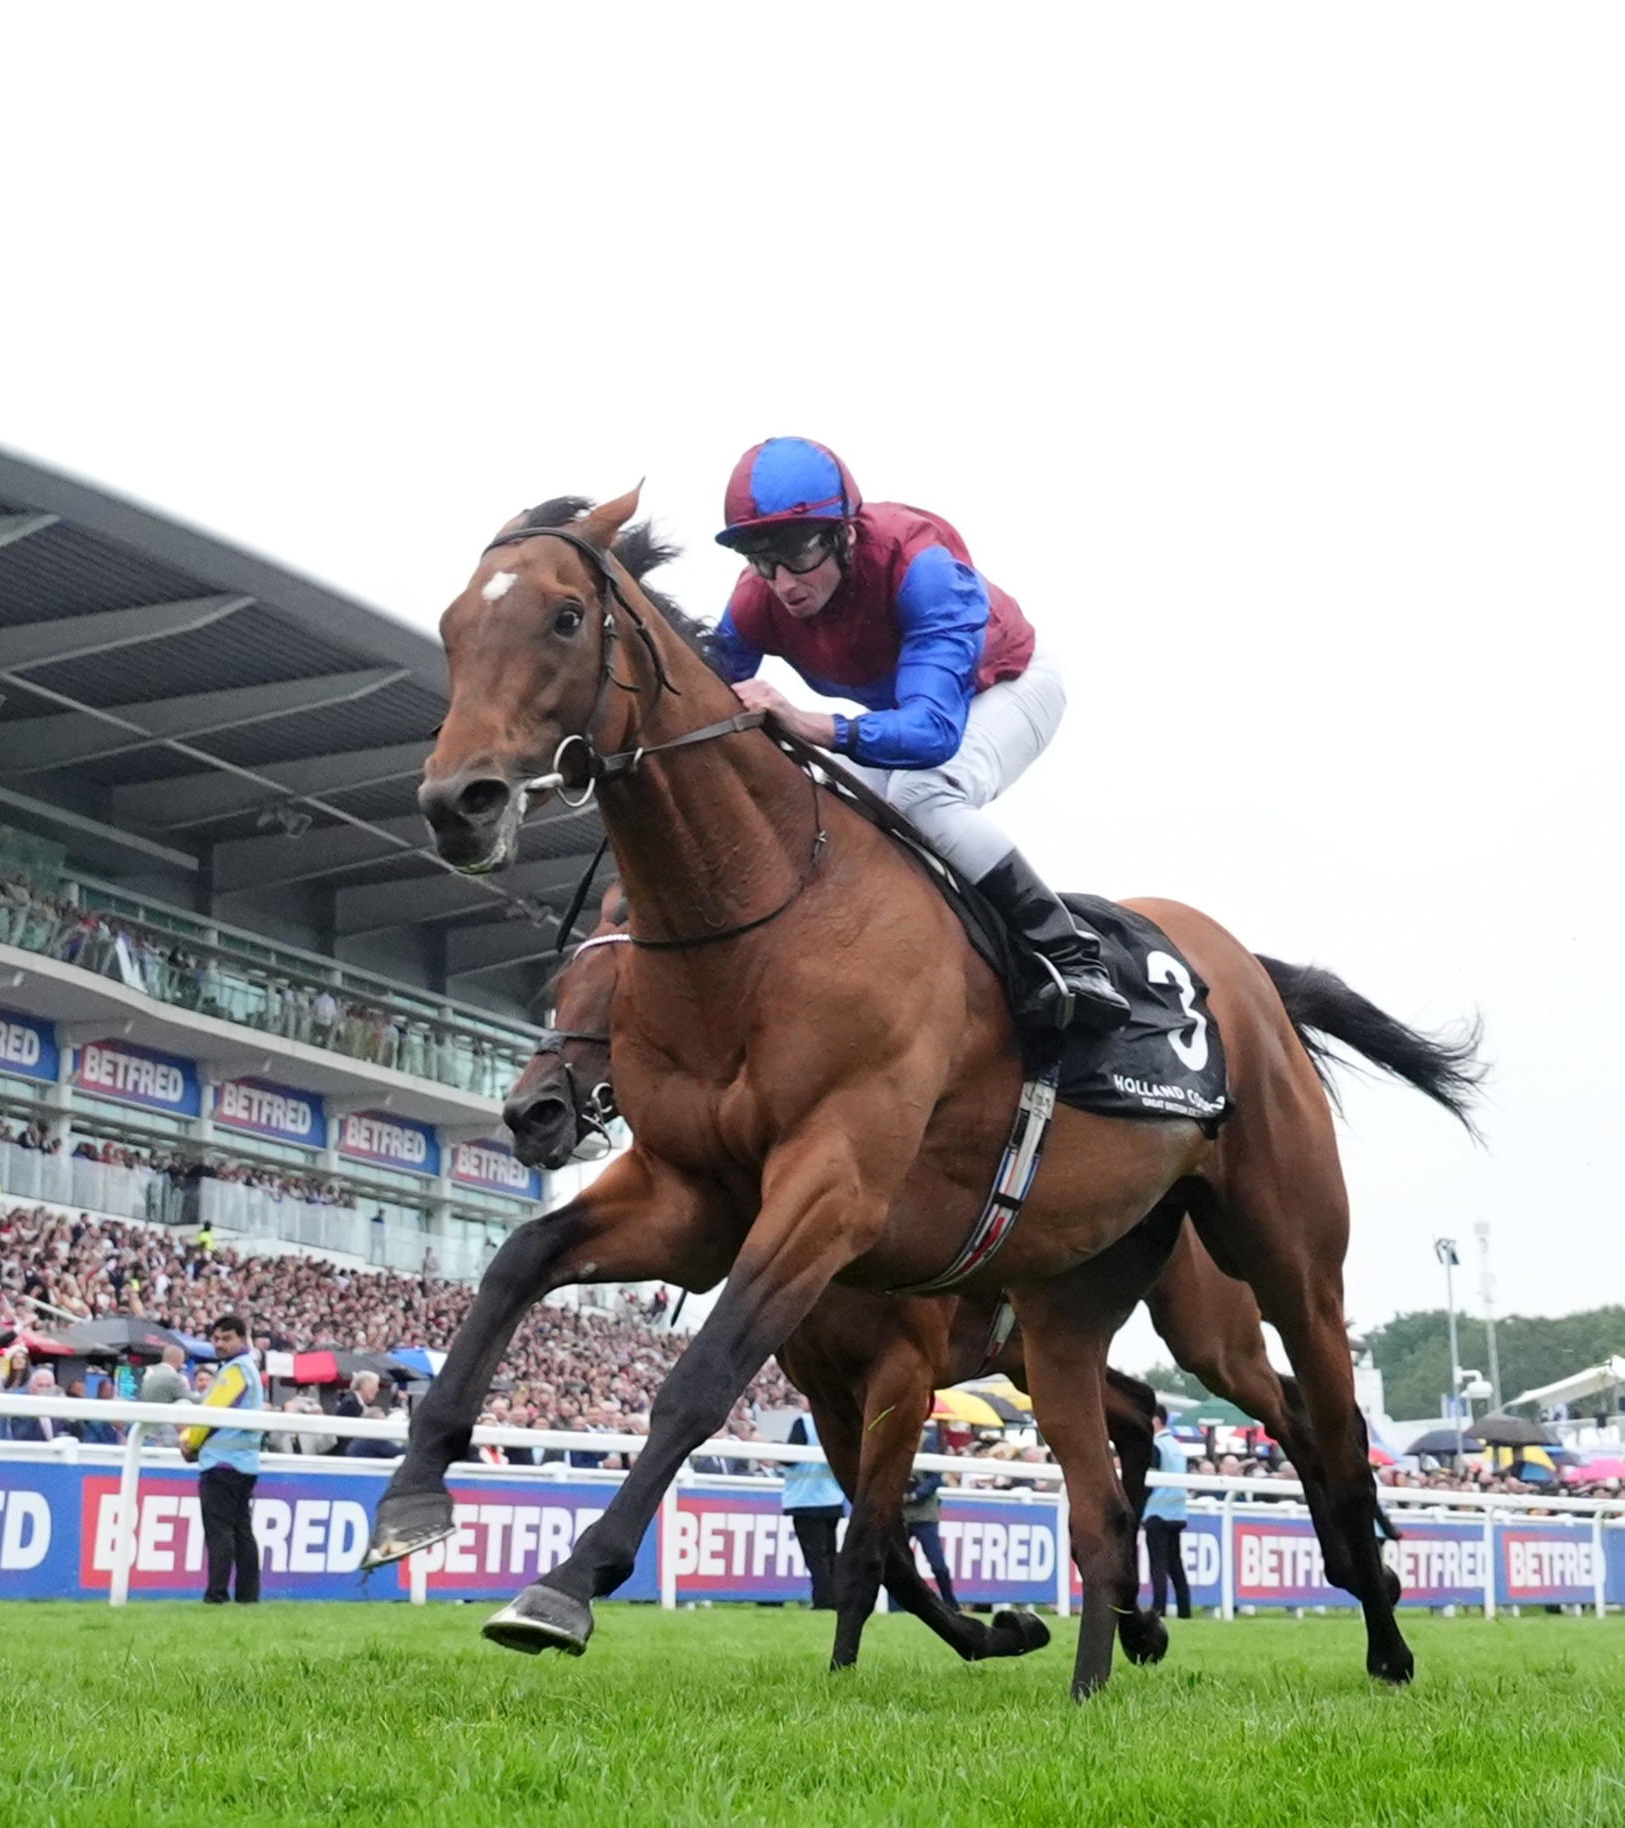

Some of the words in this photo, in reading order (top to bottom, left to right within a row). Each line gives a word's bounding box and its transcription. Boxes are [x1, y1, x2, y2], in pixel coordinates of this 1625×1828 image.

[1147, 951, 1209, 1071] 3
[82, 1045, 185, 1103] BETFRED
[1113, 1074, 1185, 1099] HOLLAND
[221, 1083, 311, 1136] BETFRED
[344, 1115, 426, 1164] BETFRED
[456, 1144, 530, 1189] BETFRED
[93, 1493, 369, 1573] BETRED
[409, 1503, 606, 1574] ETFR
[673, 1511, 851, 1577] BETFR
[909, 1520, 1055, 1582] TFRED
